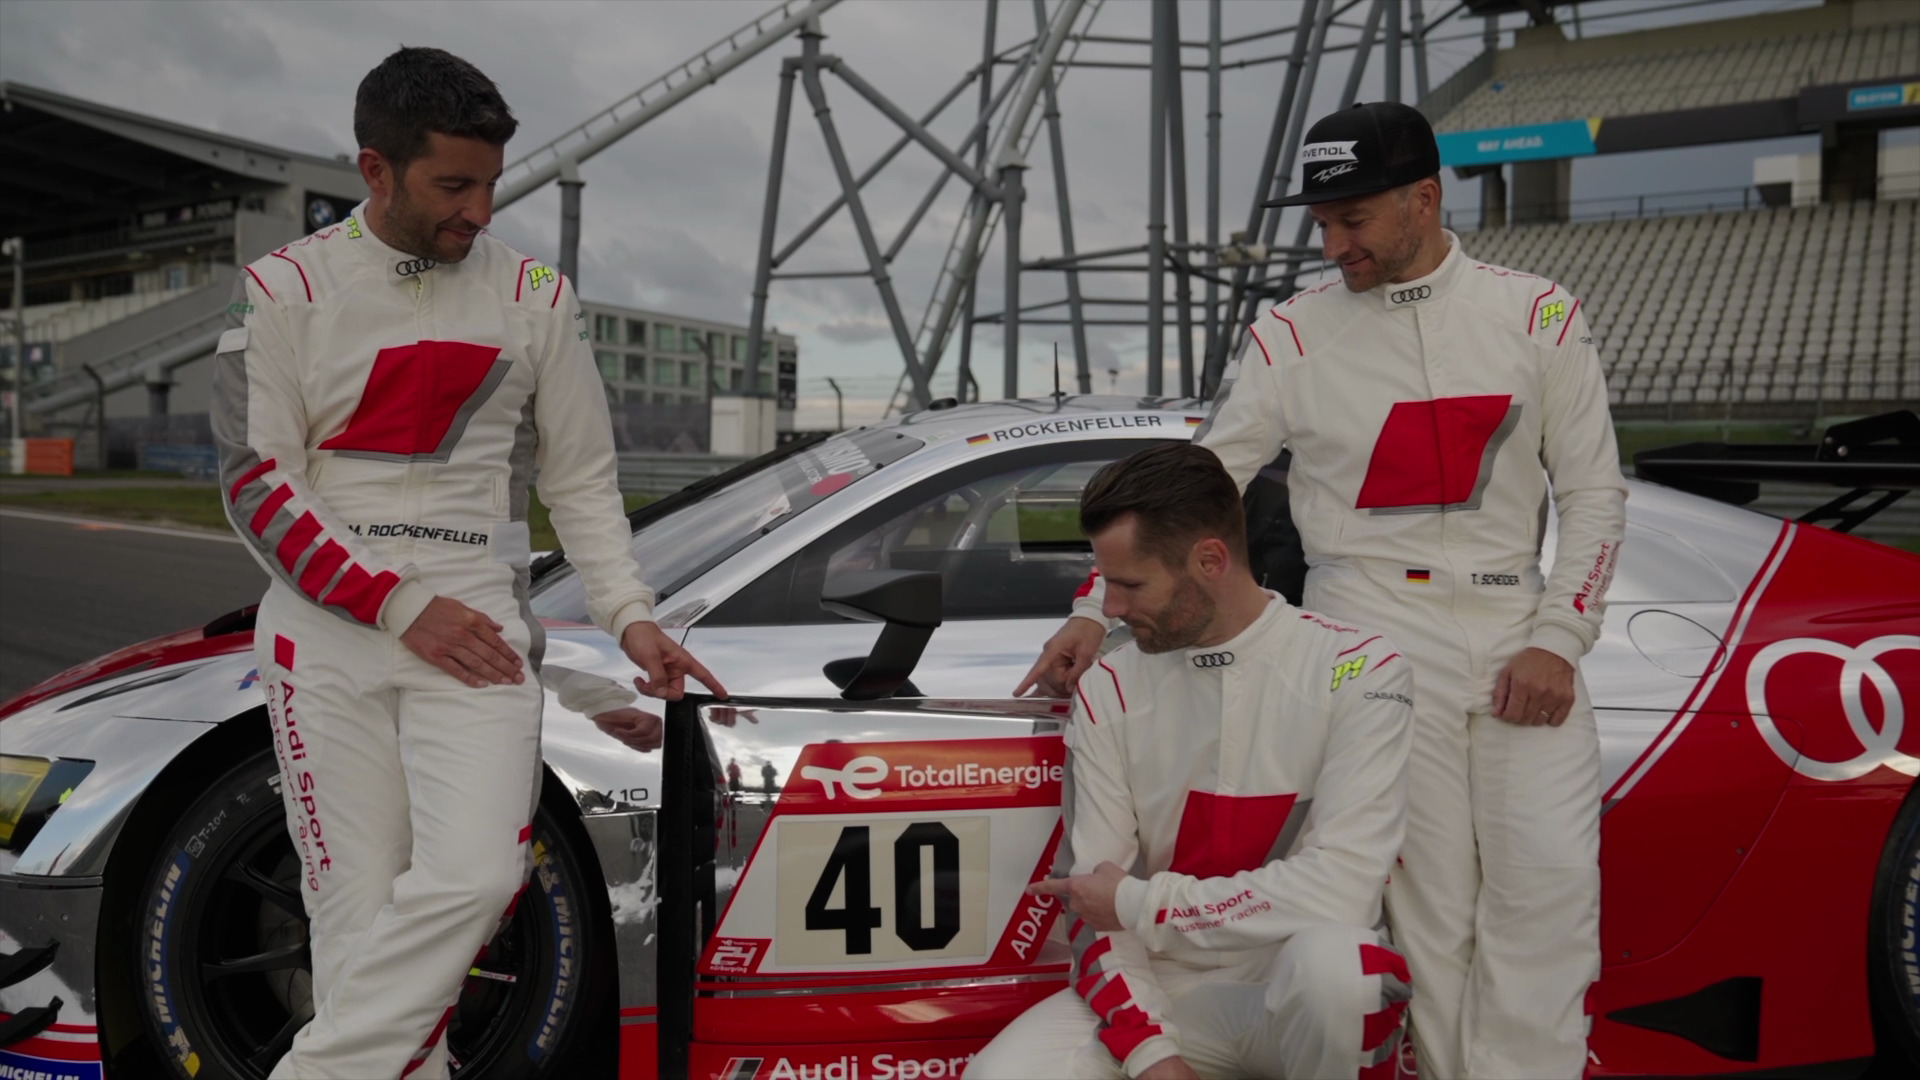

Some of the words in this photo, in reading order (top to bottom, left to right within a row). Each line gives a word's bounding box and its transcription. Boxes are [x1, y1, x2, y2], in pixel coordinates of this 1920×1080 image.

[993, 415, 1162, 442] ROCKENFELLER
[367, 523, 489, 546] ROCKENFELLER
[1588, 542, 1610, 583] Sport
[280, 680, 307, 761] Audi
[298, 771, 332, 872] Sport
[893, 758, 1065, 790] TotalEnergie
[297, 814, 319, 892] racing
[804, 821, 961, 955] 40
[1203, 889, 1254, 915] Sport
[1010, 894, 1055, 961] ADAC
[1230, 901, 1272, 922] racing
[149, 862, 183, 1024] MICHELIN
[768, 1055, 860, 1080] Audi
